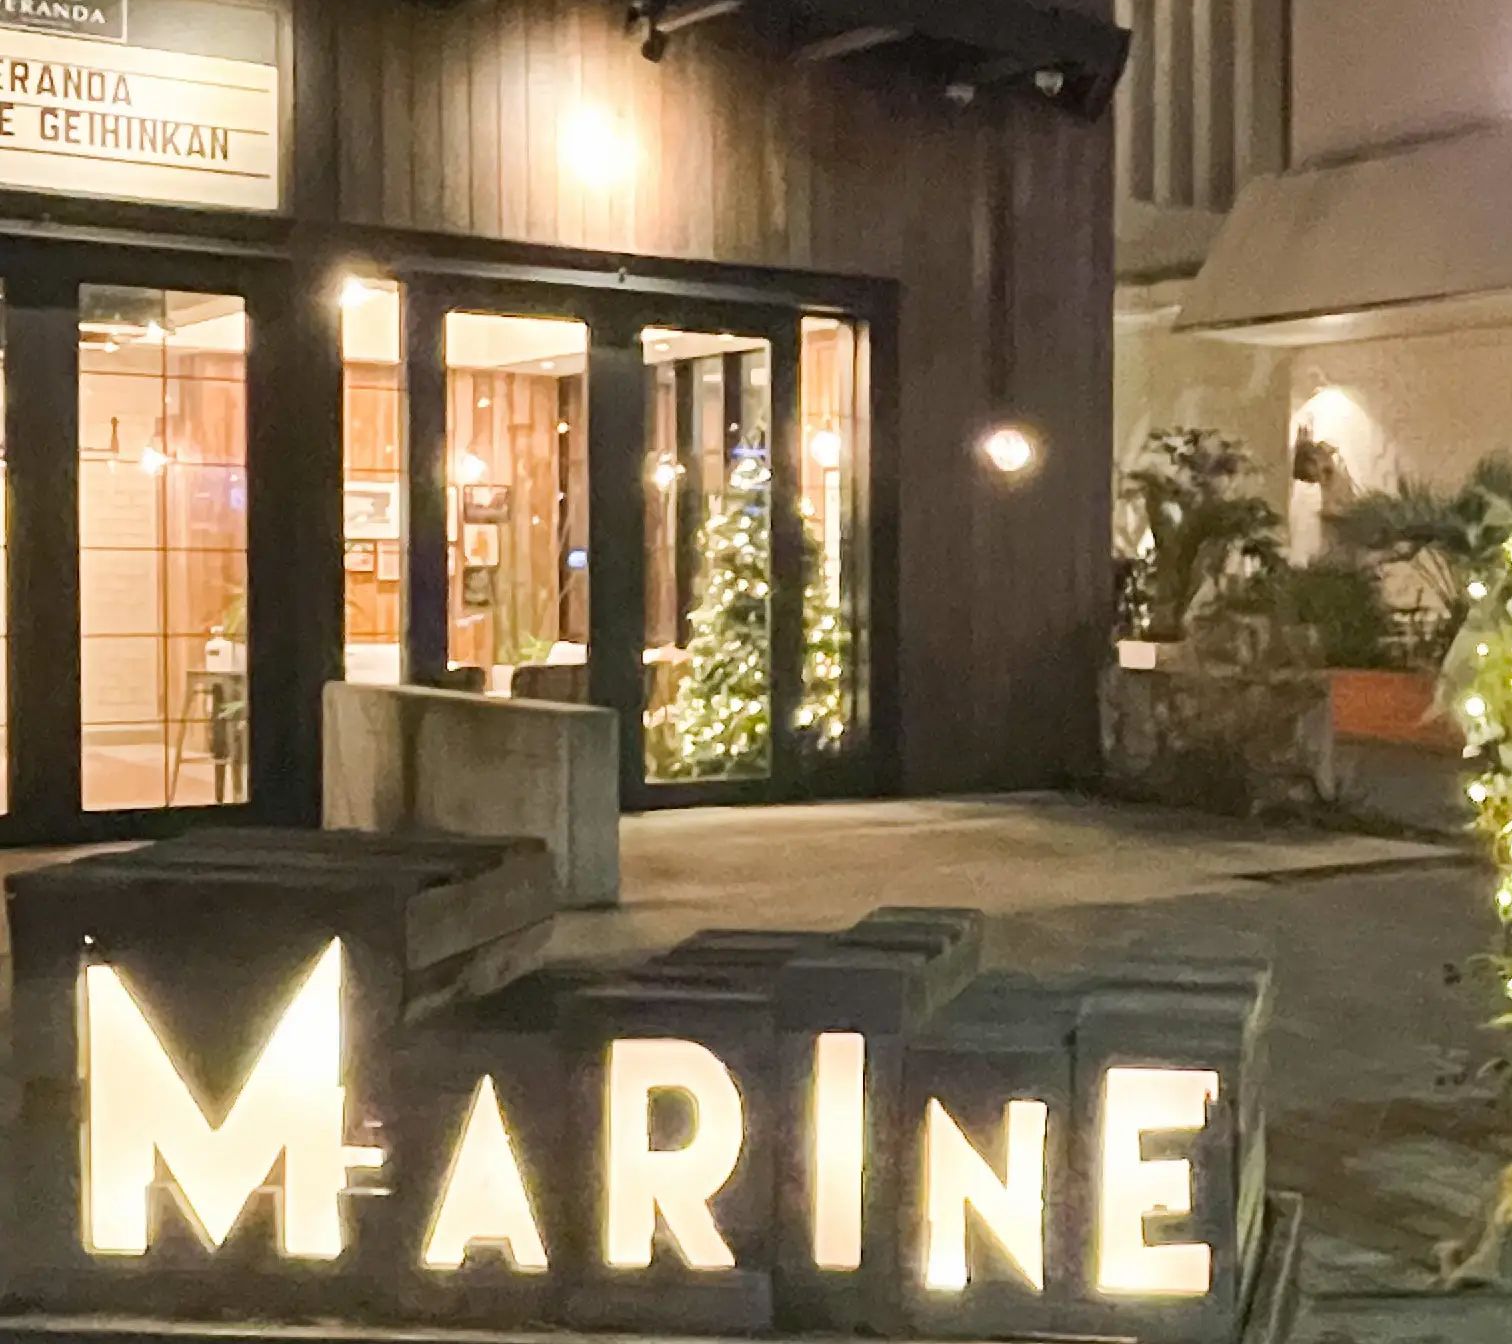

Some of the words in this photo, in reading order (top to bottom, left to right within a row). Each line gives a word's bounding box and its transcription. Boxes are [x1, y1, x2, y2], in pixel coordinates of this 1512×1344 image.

[0, 59, 132, 105] RANDA
[40, 107, 229, 160] GEIHINKAN
[80, 936, 1219, 1296] MARINE
